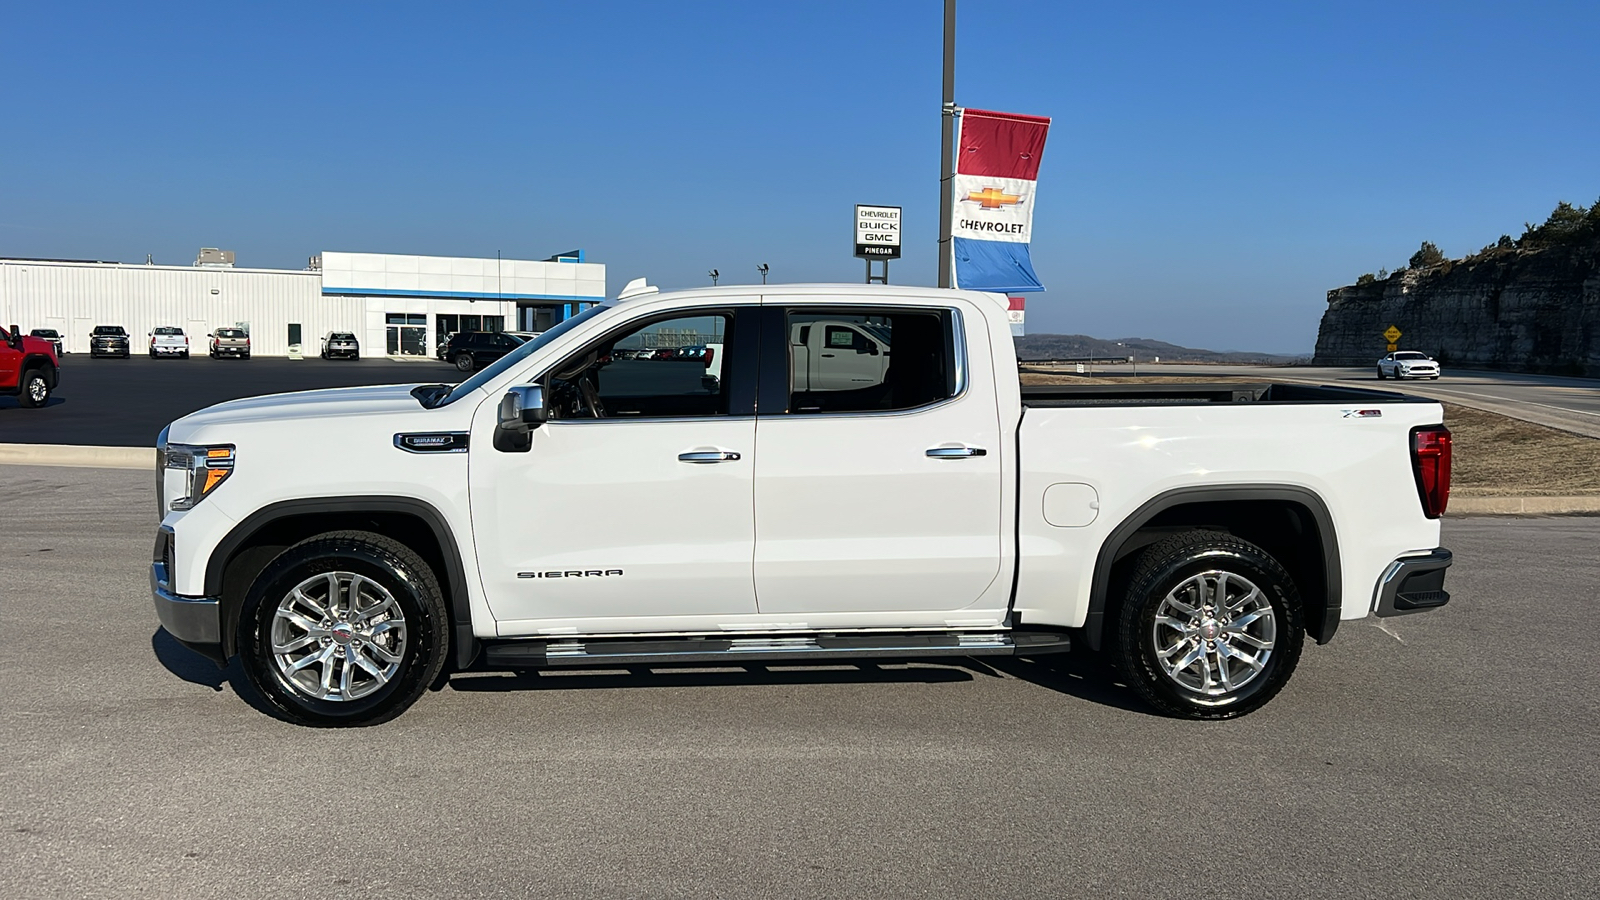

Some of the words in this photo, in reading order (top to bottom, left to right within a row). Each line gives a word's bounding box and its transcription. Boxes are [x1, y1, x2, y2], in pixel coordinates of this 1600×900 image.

[860, 210, 898, 219] CHEVROLET
[859, 221, 898, 231] BUICK
[959, 218, 1024, 234] CHEVROLET
[864, 233, 893, 242] GMC
[516, 569, 623, 579] SIERRA
